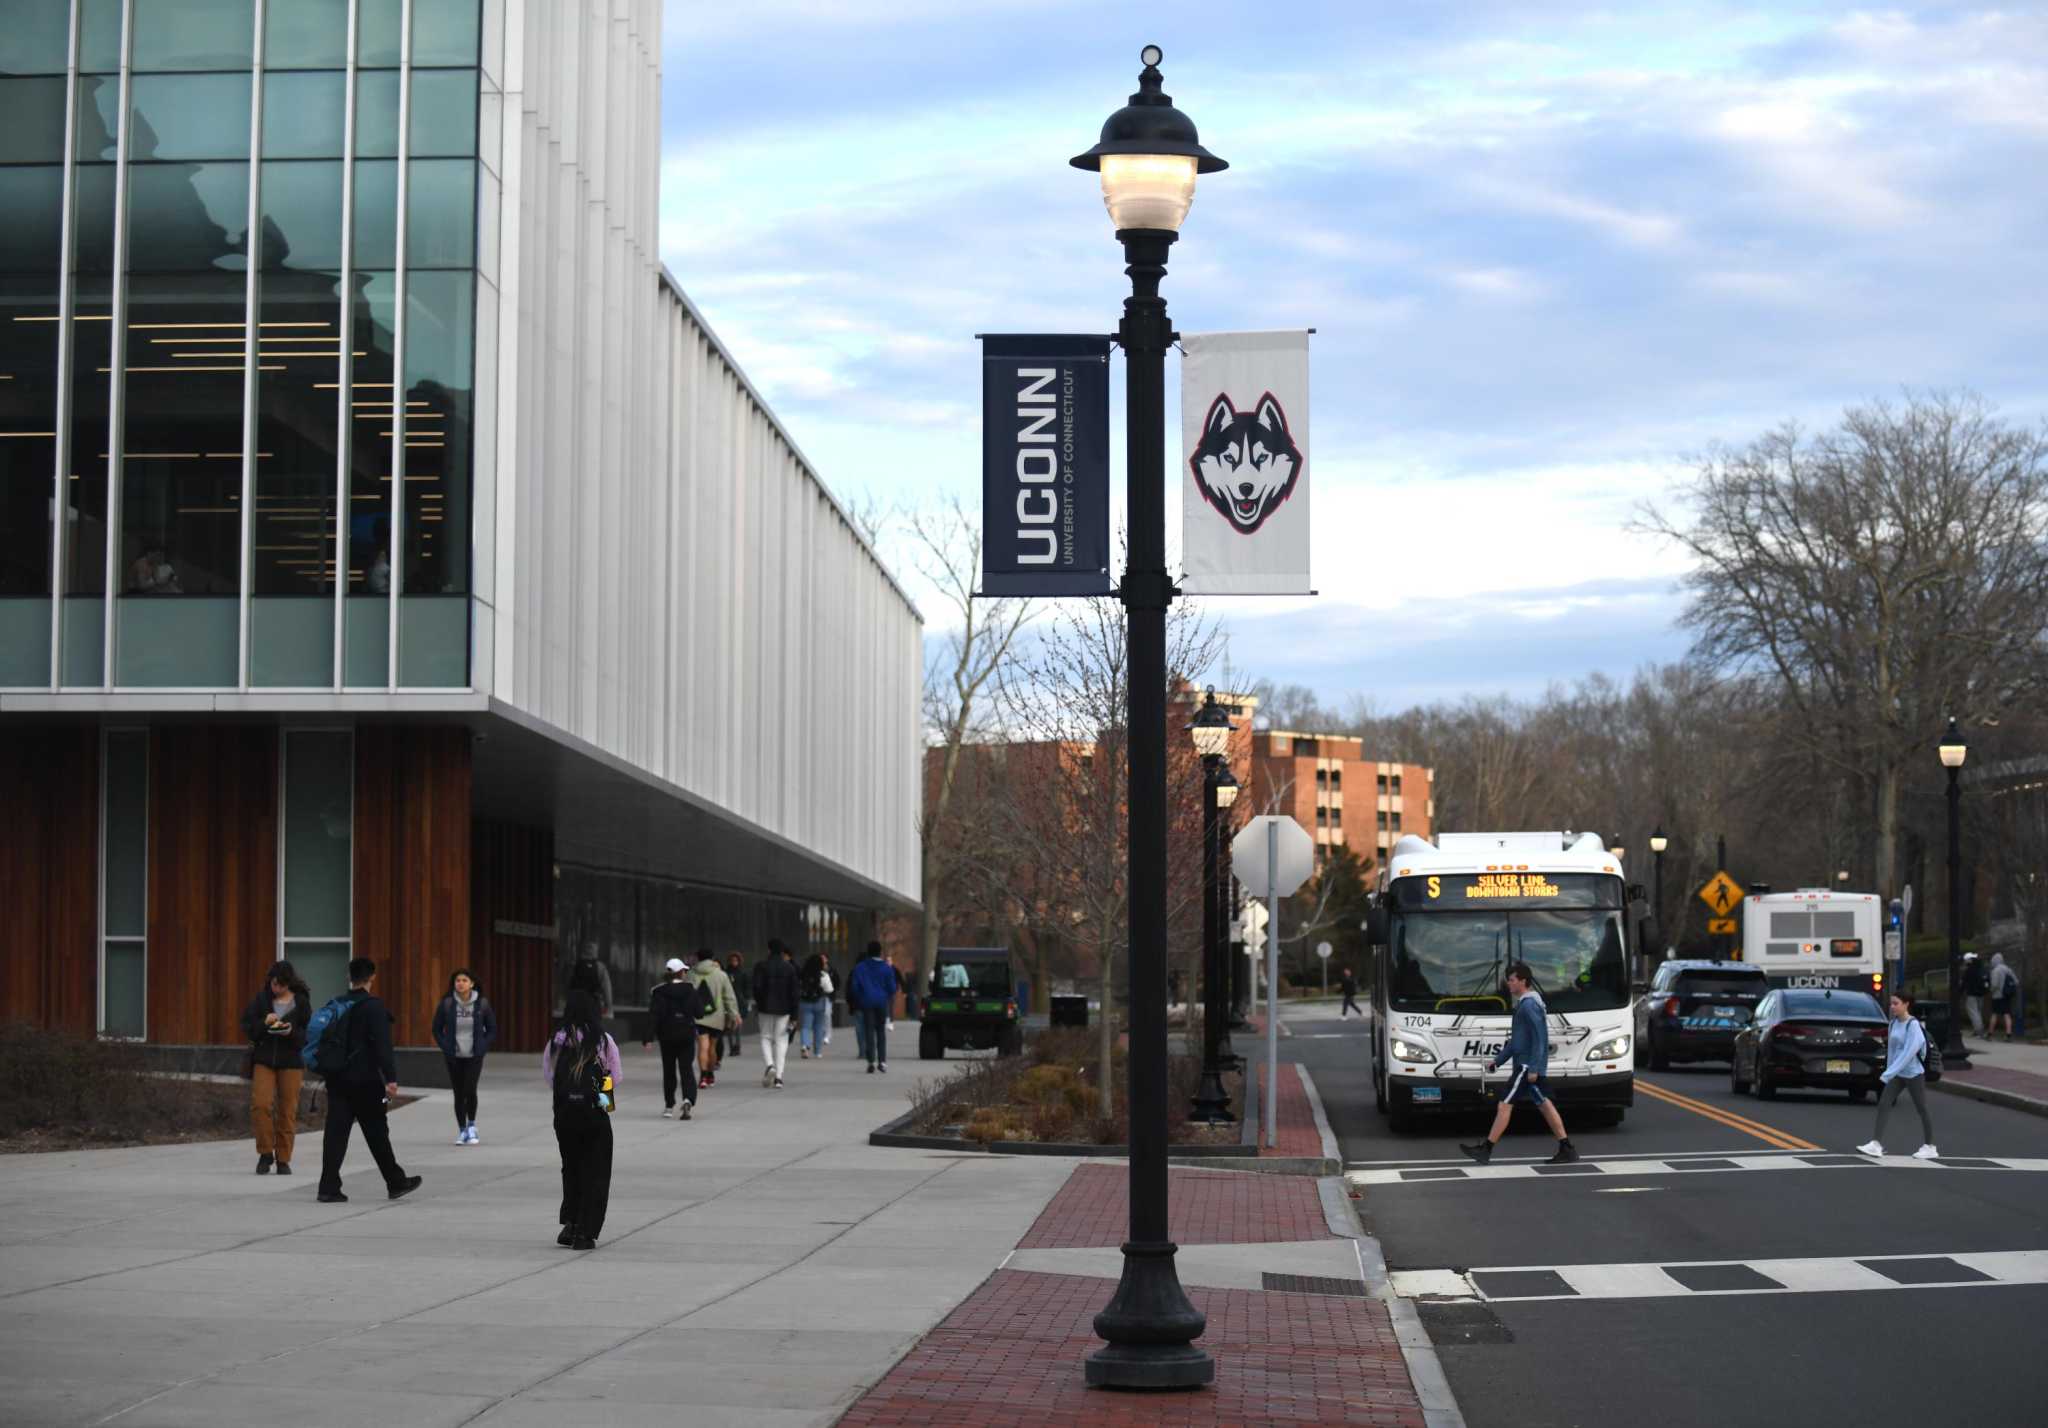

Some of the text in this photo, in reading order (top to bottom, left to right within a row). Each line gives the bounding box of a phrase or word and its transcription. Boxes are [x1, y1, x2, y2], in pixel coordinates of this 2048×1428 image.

[1016, 368, 1057, 564] UCONN
[1064, 369, 1073, 565] UNIVERSITY OF CONNECTICUT
[1427, 876, 1440, 898] S
[1478, 875, 1546, 887] SILVER LINE
[1466, 885, 1558, 897] DOWNTOWN STORRS
[1788, 976, 1839, 988] UCONN
[1404, 1016, 1432, 1027] 1704
